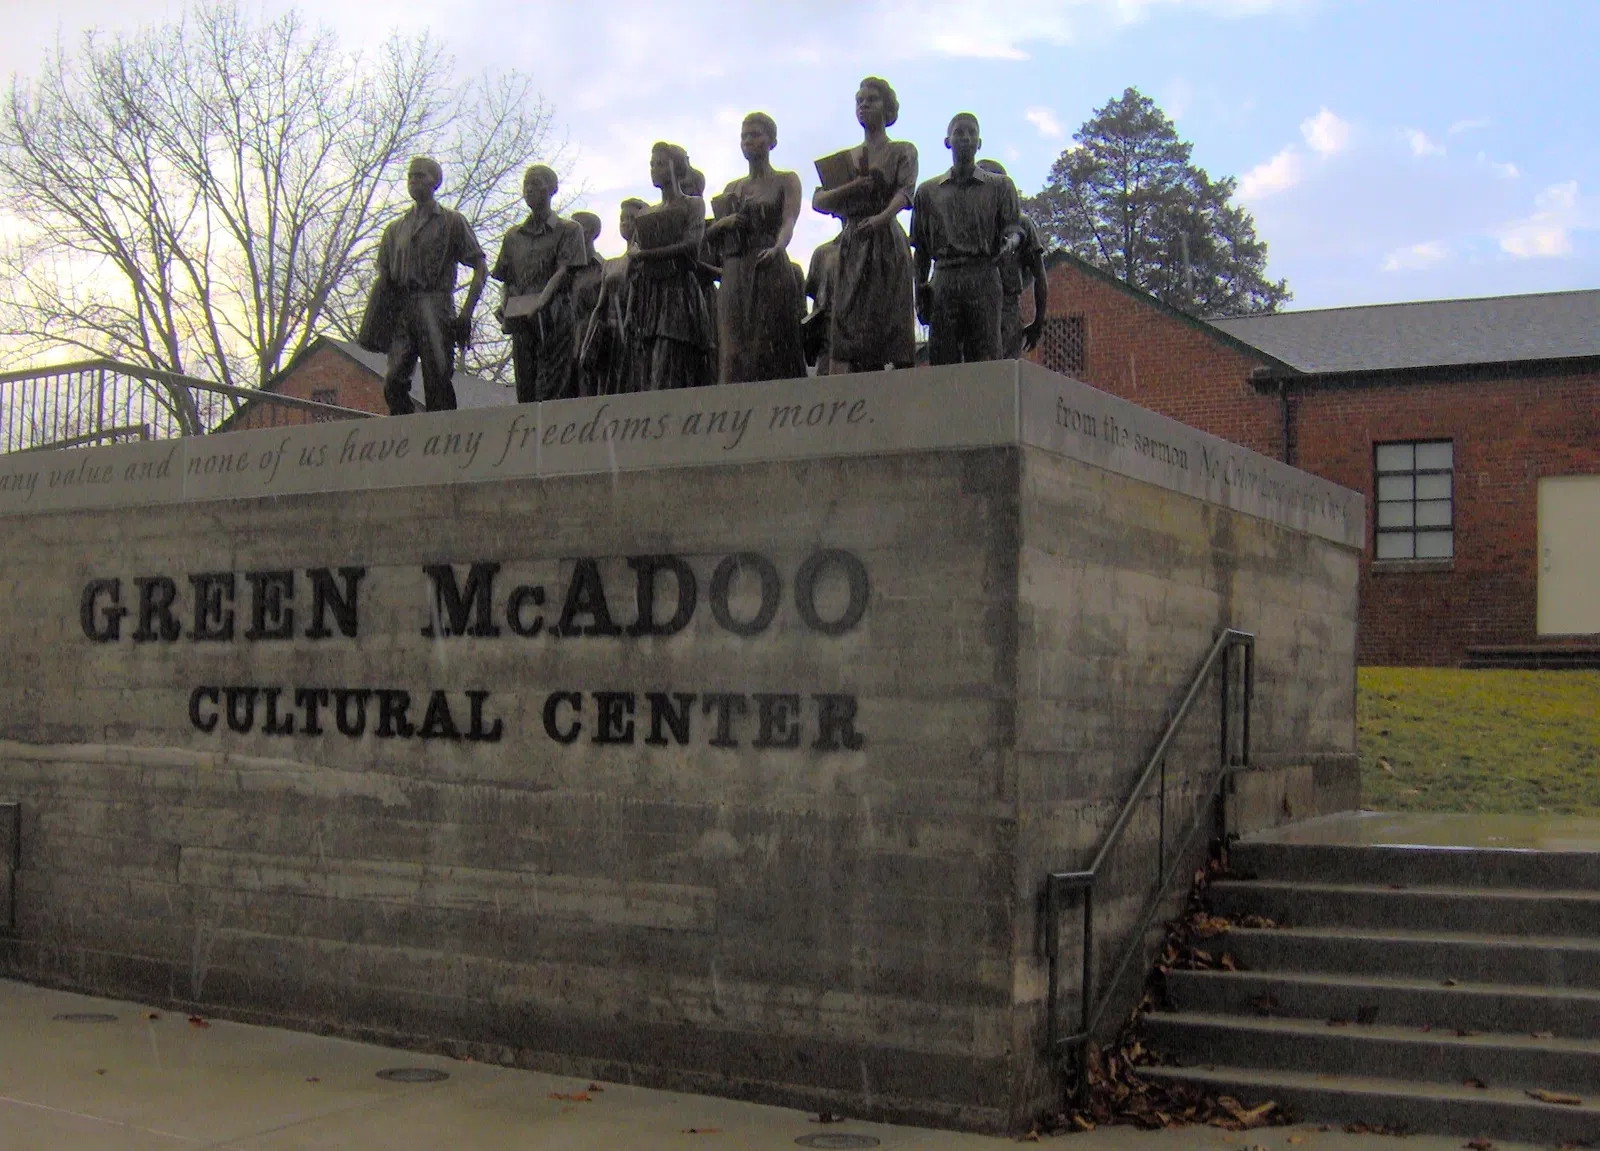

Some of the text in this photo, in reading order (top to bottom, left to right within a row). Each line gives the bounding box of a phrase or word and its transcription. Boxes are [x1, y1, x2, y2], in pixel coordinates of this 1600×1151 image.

[0, 398, 876, 500] any value and none of us have any freedoms any more.
[1055, 396, 1098, 438] from
[1104, 416, 1130, 447] the
[1134, 432, 1189, 470] sermon
[79, 548, 870, 644] GREEN McADOO
[188, 685, 865, 751] CULTURAL CENTER
